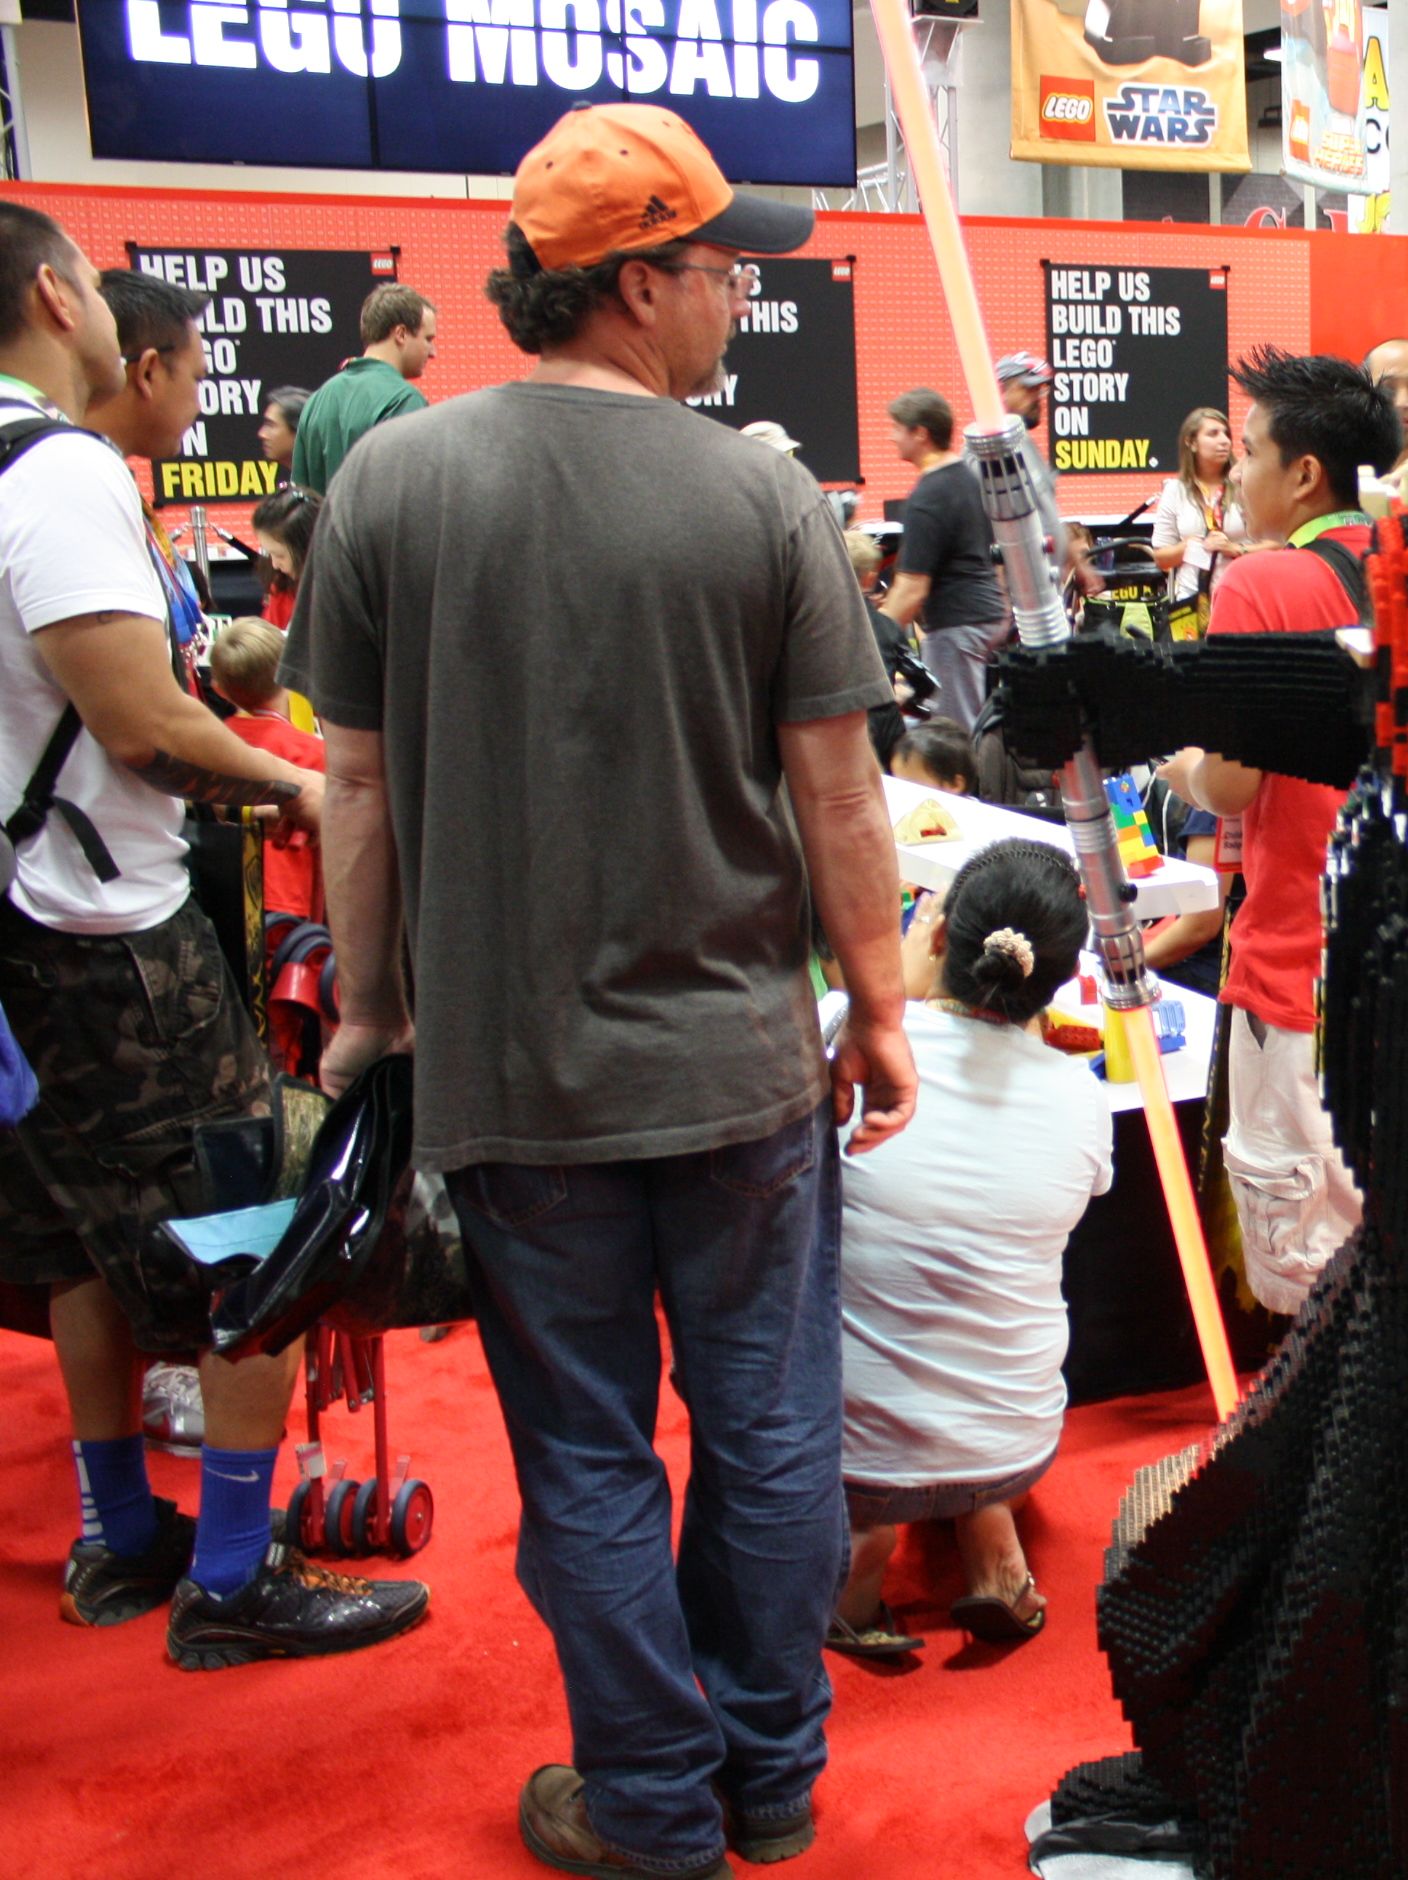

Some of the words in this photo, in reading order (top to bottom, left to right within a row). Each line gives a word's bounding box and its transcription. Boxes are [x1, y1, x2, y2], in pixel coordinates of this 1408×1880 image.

[126, 0, 402, 78] LEGO
[444, 0, 820, 103] MOSAIC
[1043, 94, 1092, 122] LEGO
[1106, 86, 1216, 116] STAR
[1106, 113, 1216, 144] WARS
[140, 254, 229, 292] HELP
[239, 256, 287, 292] US
[373, 258, 393, 270] LEGO
[1051, 270, 1111, 301] HELP
[1118, 272, 1151, 302] US
[256, 298, 333, 333] THIS
[1052, 304, 1122, 335] BUILD
[1128, 306, 1181, 336] THIS
[203, 338, 237, 374] GO
[1052, 338, 1113, 369] LEGO
[199, 379, 262, 416] ORY
[1054, 372, 1129, 403] STORY
[1054, 406, 1089, 436] ON
[161, 460, 279, 498] FRIDAY
